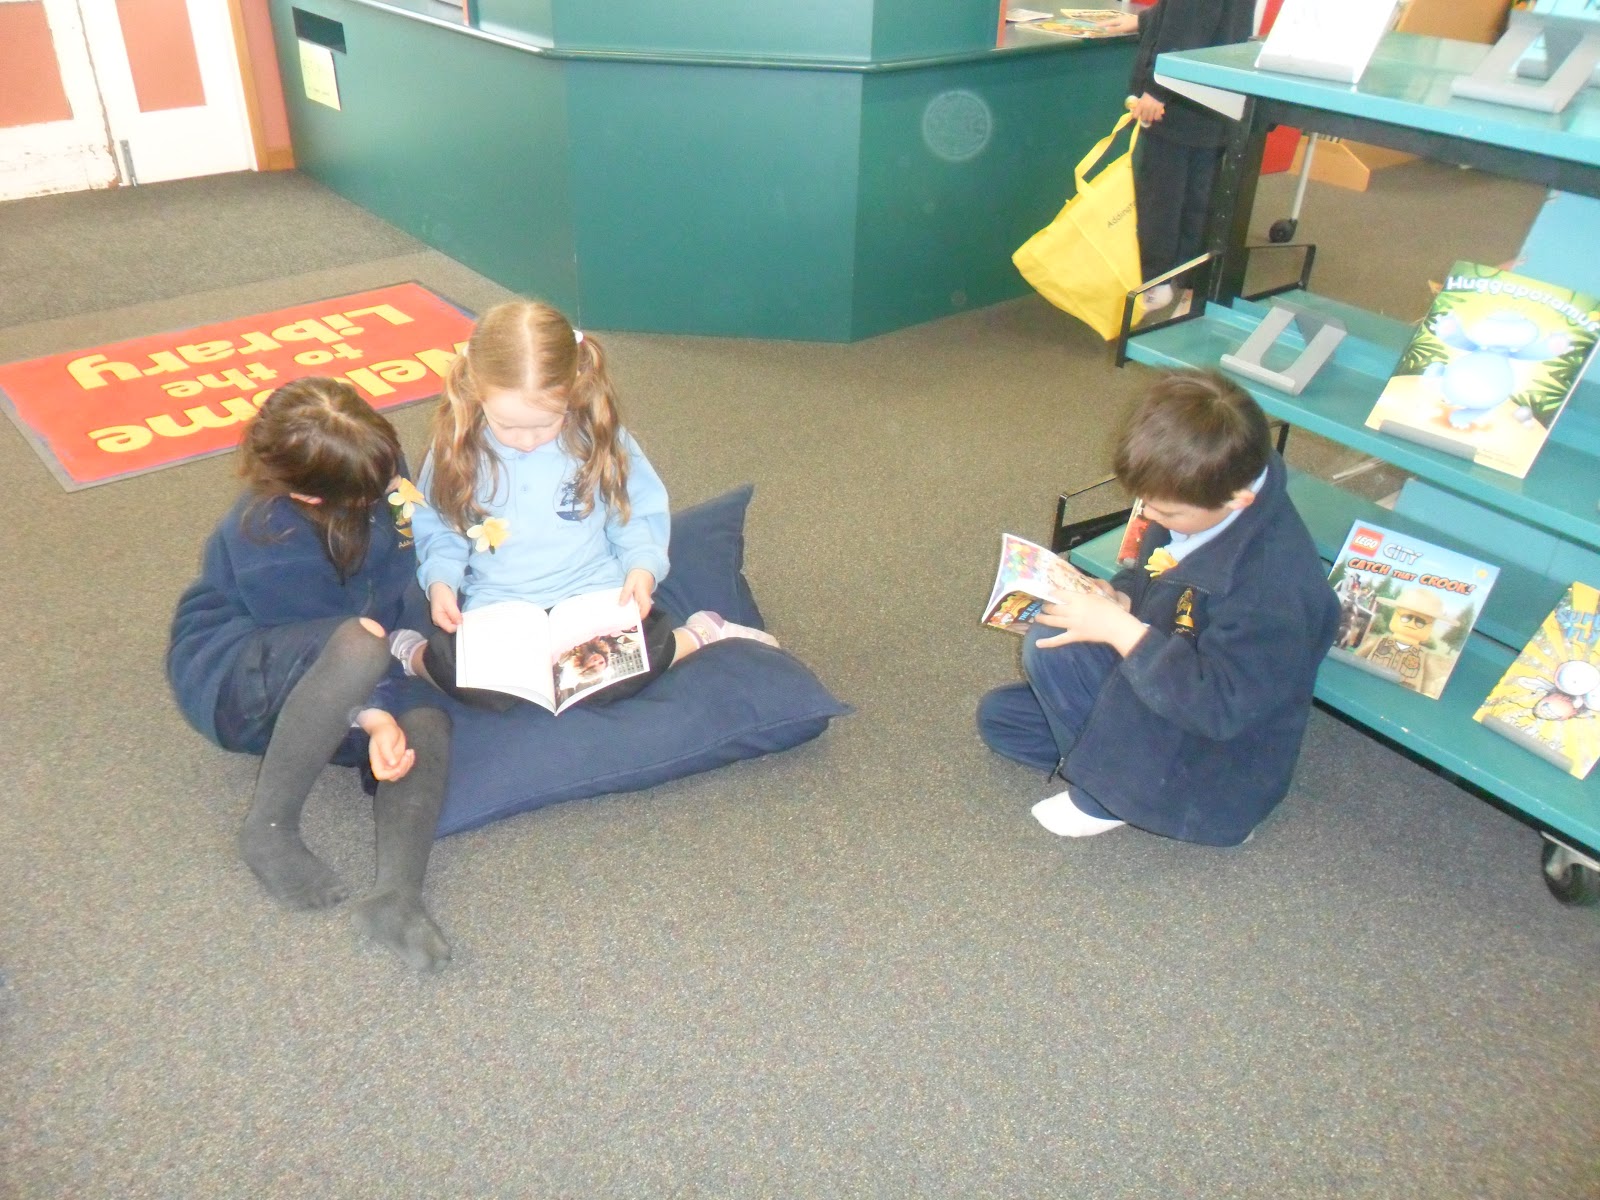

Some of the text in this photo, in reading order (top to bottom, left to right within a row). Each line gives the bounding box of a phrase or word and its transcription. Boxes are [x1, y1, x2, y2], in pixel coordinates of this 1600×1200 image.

[67, 304, 415, 390] Library
[160, 343, 363, 397] to the
[1354, 534, 1379, 550] LEGO
[1348, 557, 1477, 596] CATCH THAT CROOK!
